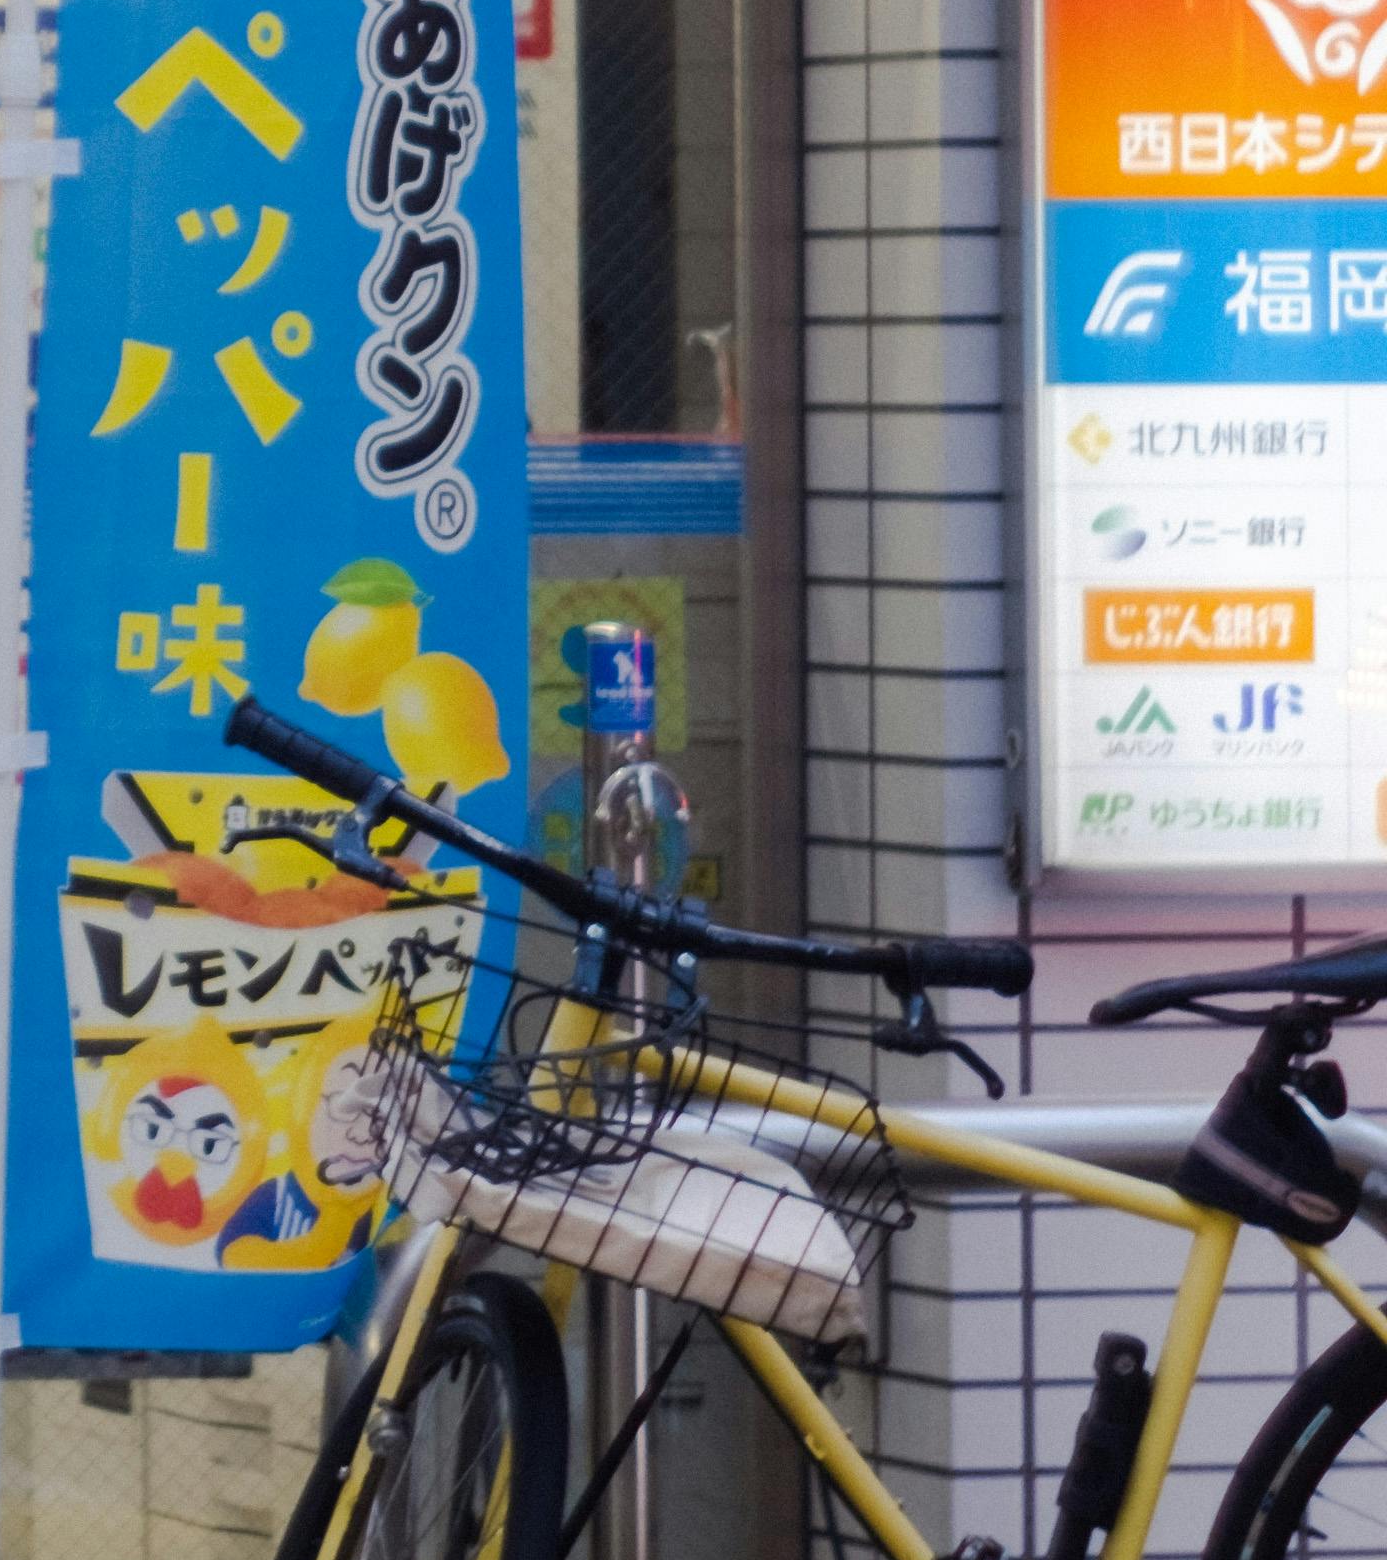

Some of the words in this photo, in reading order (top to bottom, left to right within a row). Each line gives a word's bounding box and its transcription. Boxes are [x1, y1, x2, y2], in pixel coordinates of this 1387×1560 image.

[1225, 249, 1387, 334] 福岡
[1128, 420, 1327, 457] 北九州銀行
[1161, 516, 1307, 549] ソニー銀行
[1104, 605, 1294, 650] じぶん銀行
[1149, 797, 1321, 830] ゆうちょ銀行
